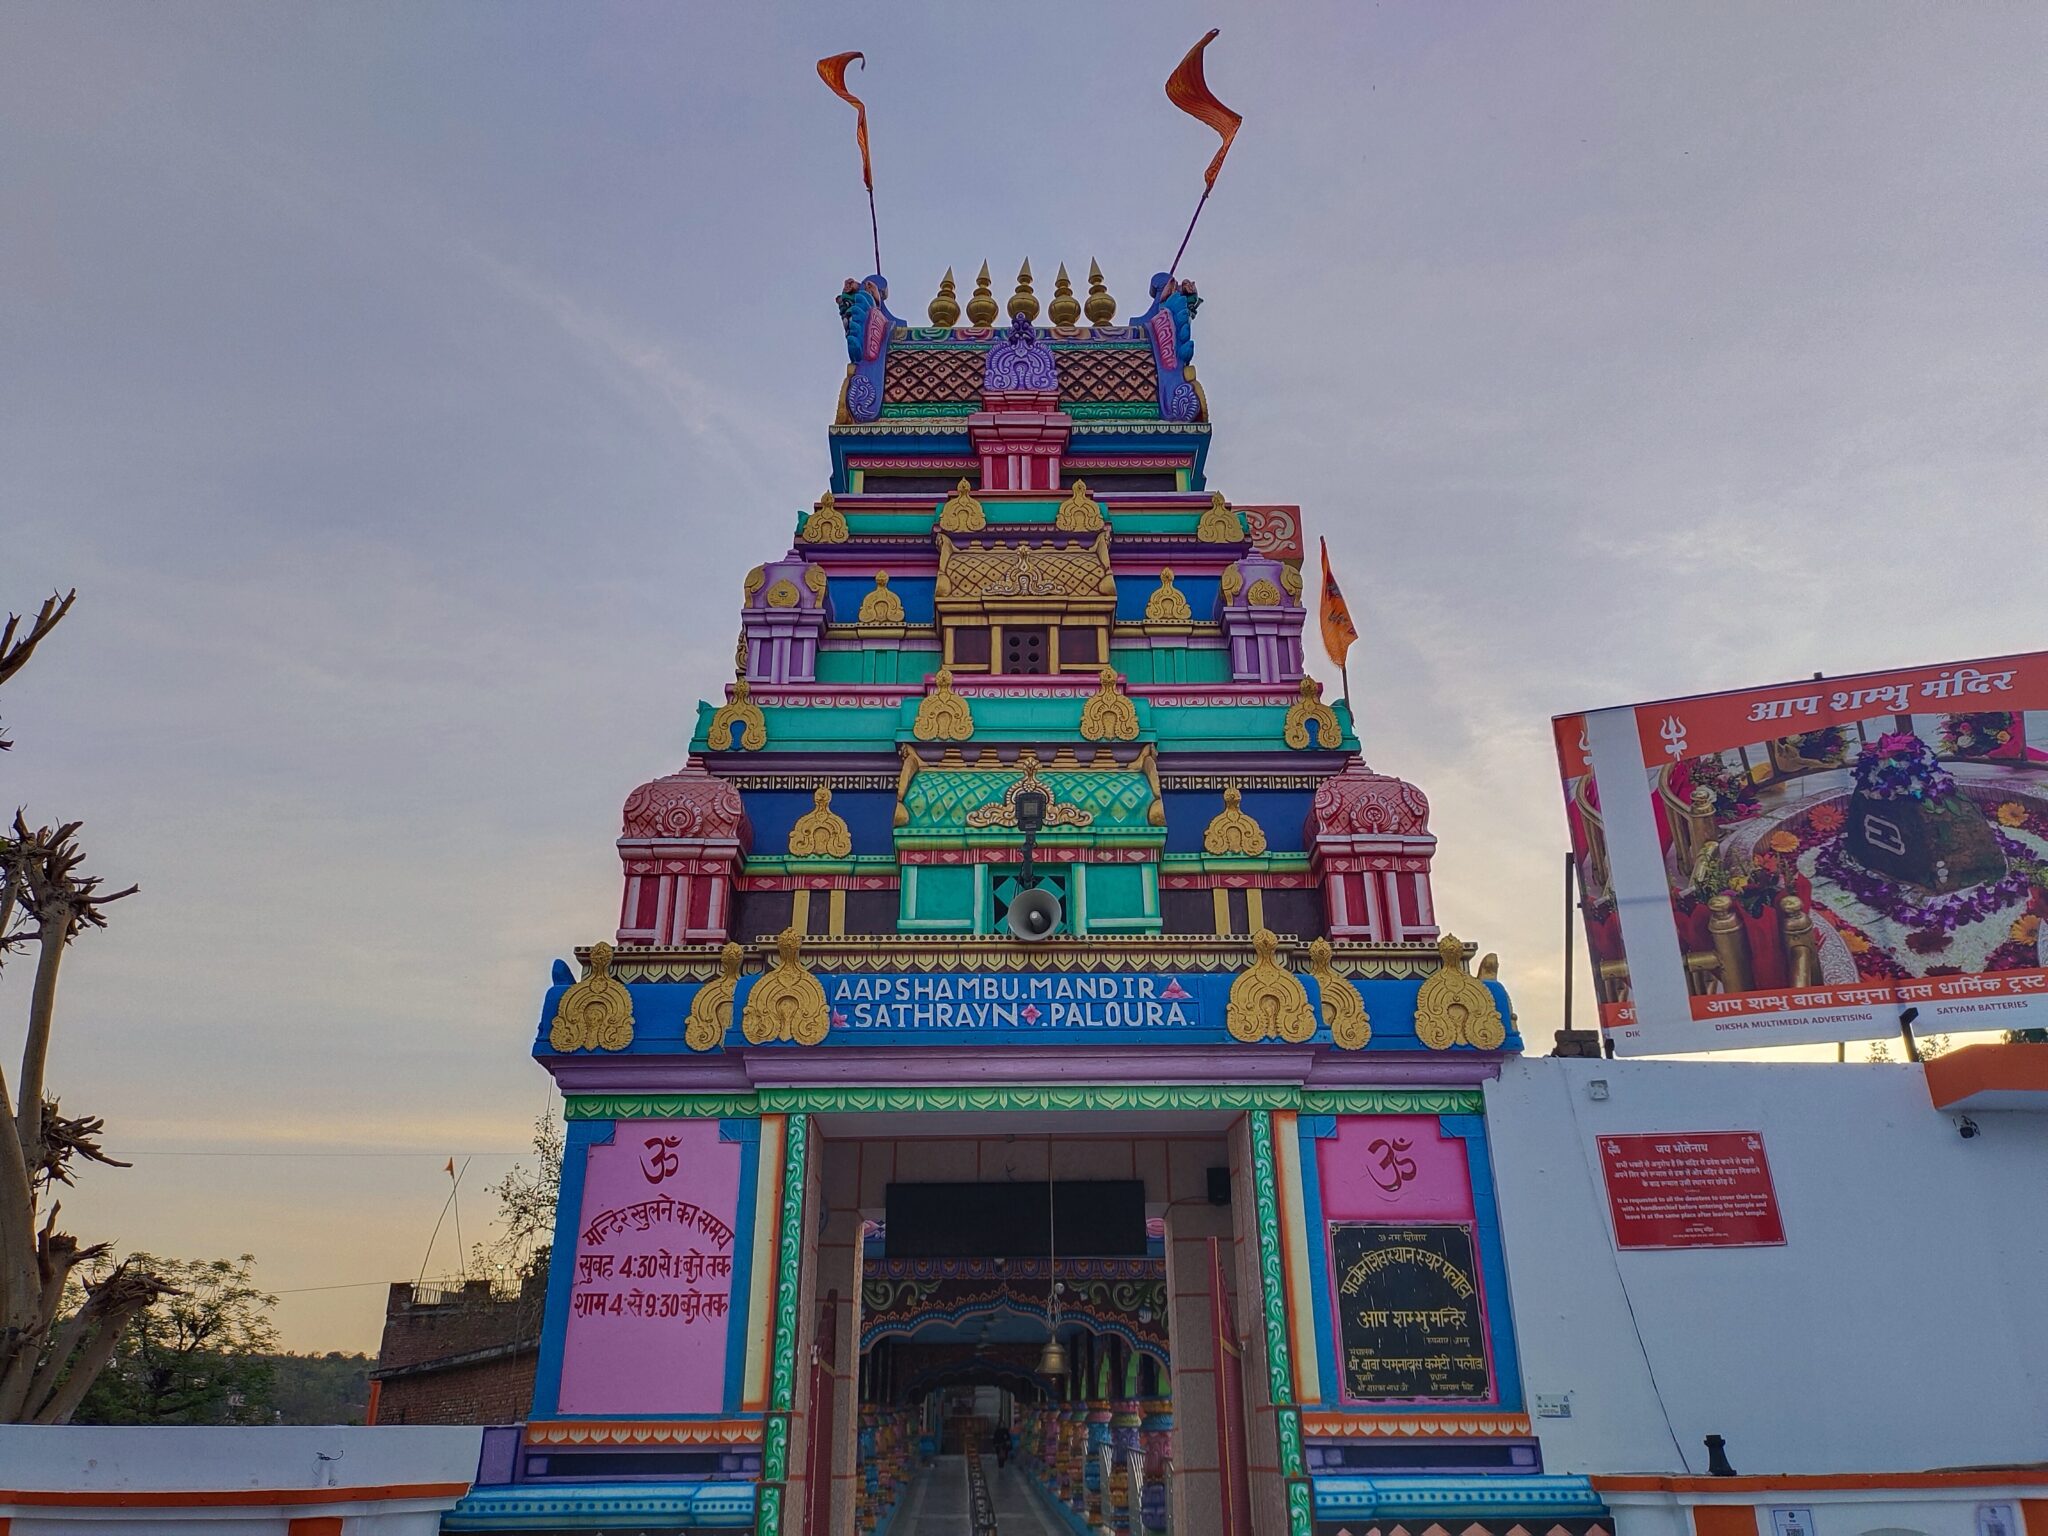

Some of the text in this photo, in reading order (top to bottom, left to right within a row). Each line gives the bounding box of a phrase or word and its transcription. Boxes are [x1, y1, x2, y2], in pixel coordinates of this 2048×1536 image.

[1747, 668, 2017, 722] आप शम्भु मंदिर
[1707, 974, 2046, 1014] आप शम्भु बाबा जमुना दास धार्मिक ट्रस्ट
[853, 1002, 1018, 1028] SATHRAYN
[1936, 1000, 2029, 1015] SATYAM BATTERIES
[1715, 1013, 1873, 1032] DIKSHA MULTIMEDIA ADVERTISING
[627, 1193, 676, 1232] खुलने
[677, 1200, 700, 1229] का
[698, 1210, 735, 1251] समय
[706, 1255, 731, 1280] तक
[574, 1292, 609, 1318] शाम
[702, 1293, 728, 1322] तक
[1357, 1311, 1389, 1328] आप
